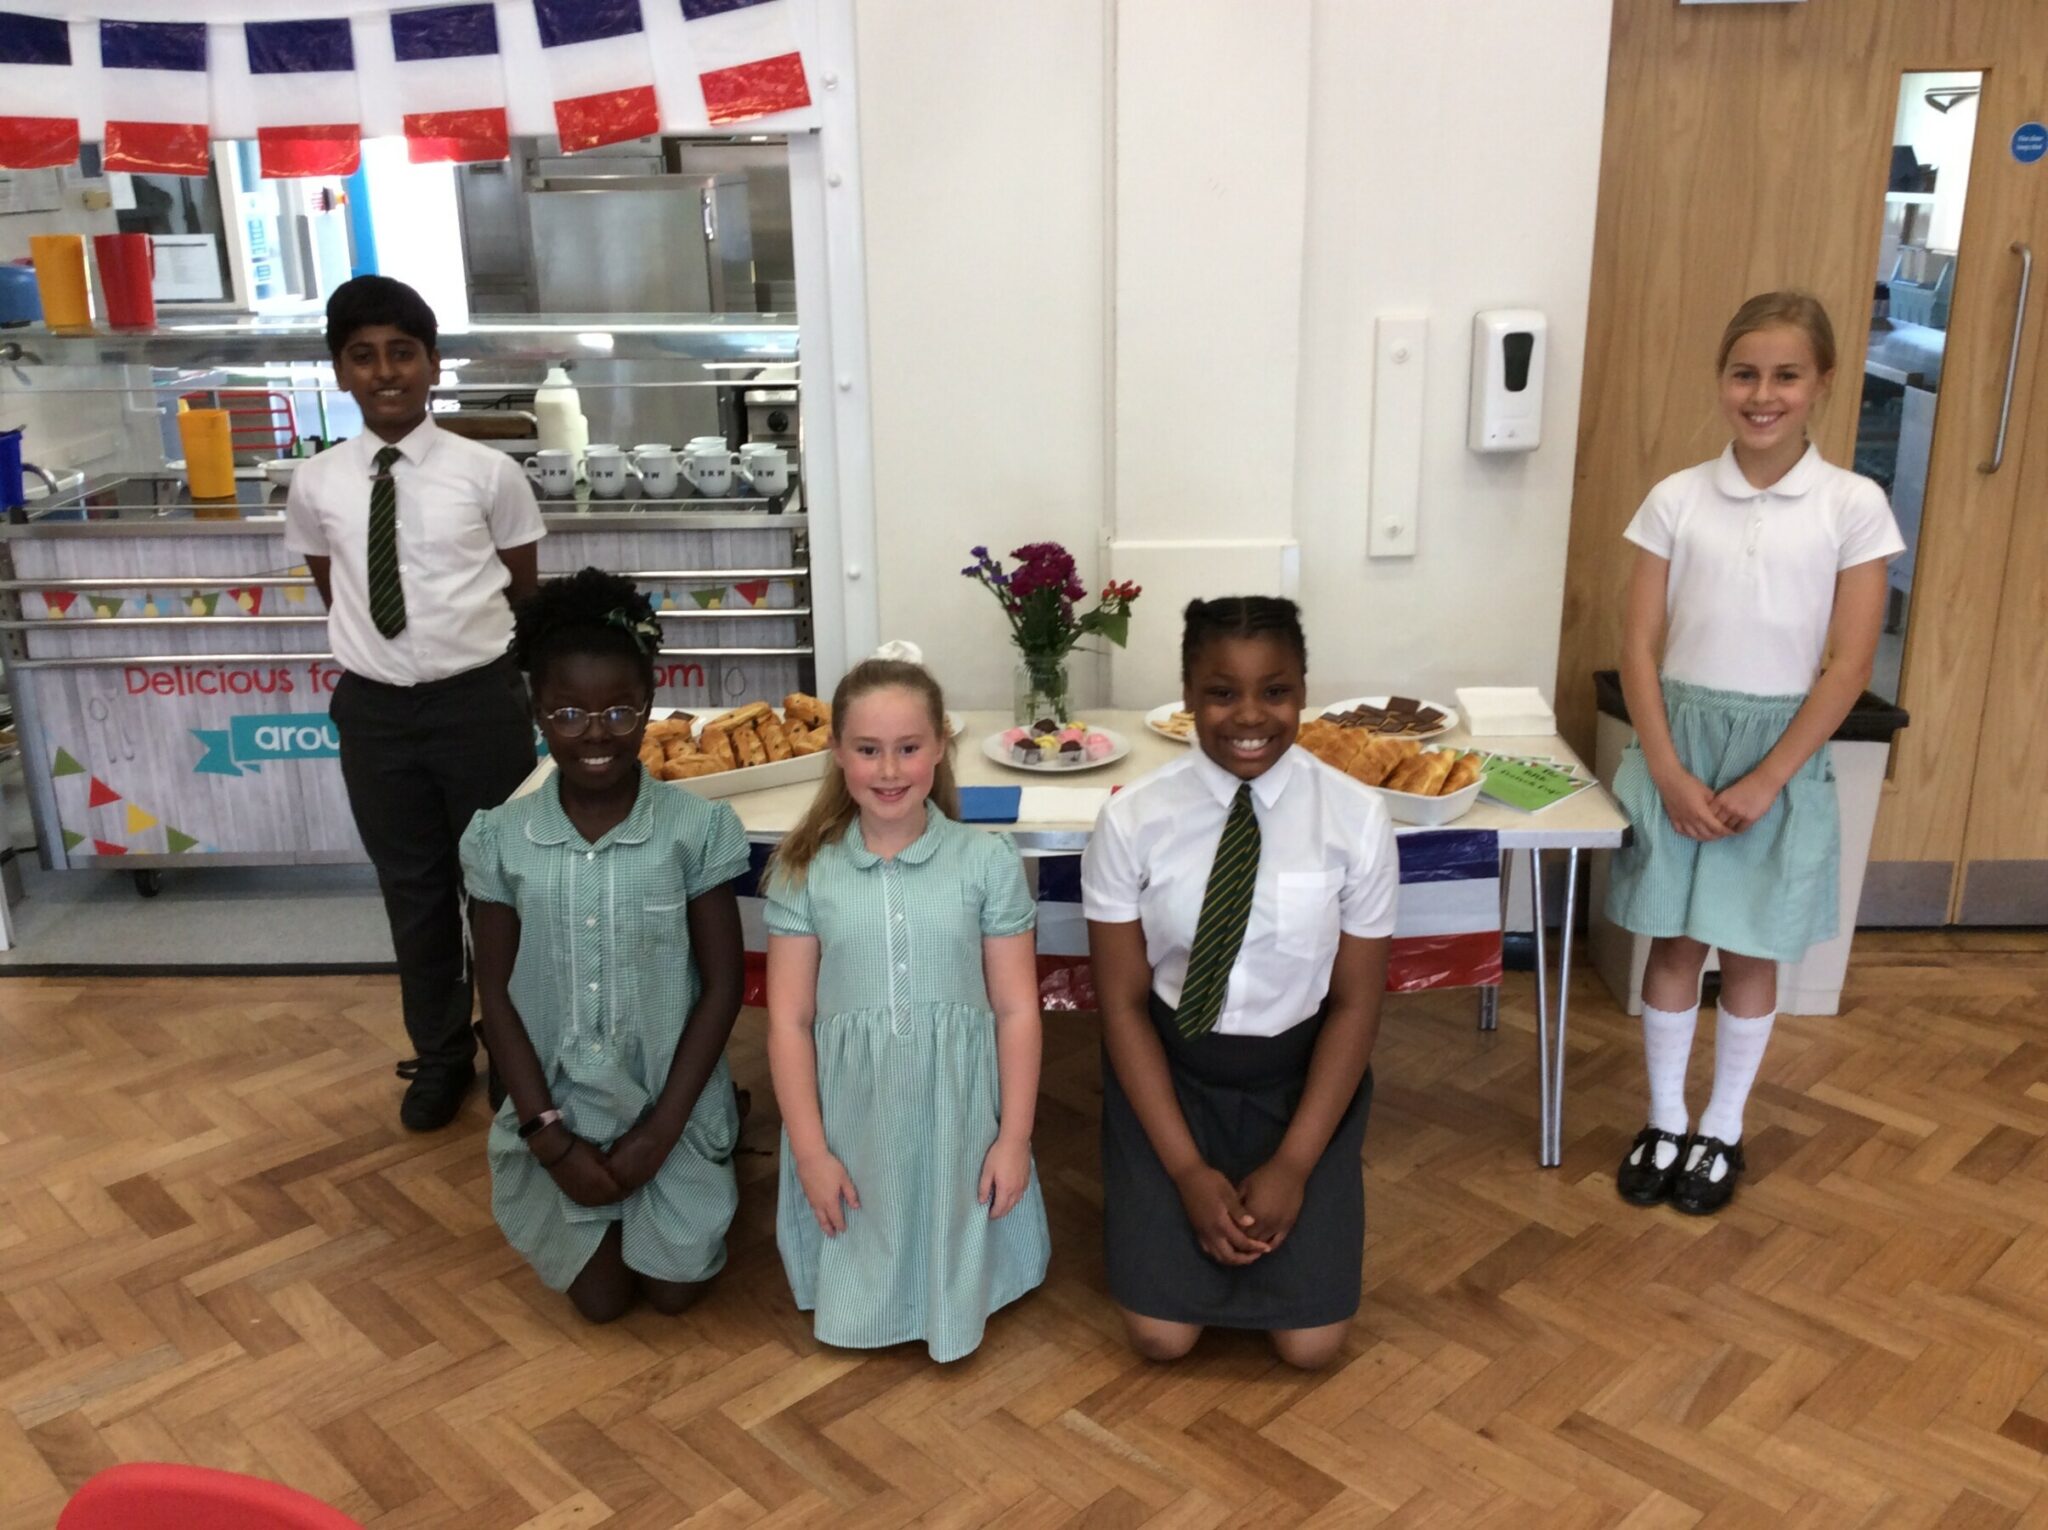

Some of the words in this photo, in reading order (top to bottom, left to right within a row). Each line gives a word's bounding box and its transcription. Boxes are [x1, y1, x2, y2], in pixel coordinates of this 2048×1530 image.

[124, 664, 294, 696] Delicious
[308, 661, 345, 693] fo
[653, 663, 704, 688] om
[254, 724, 340, 752] arou
